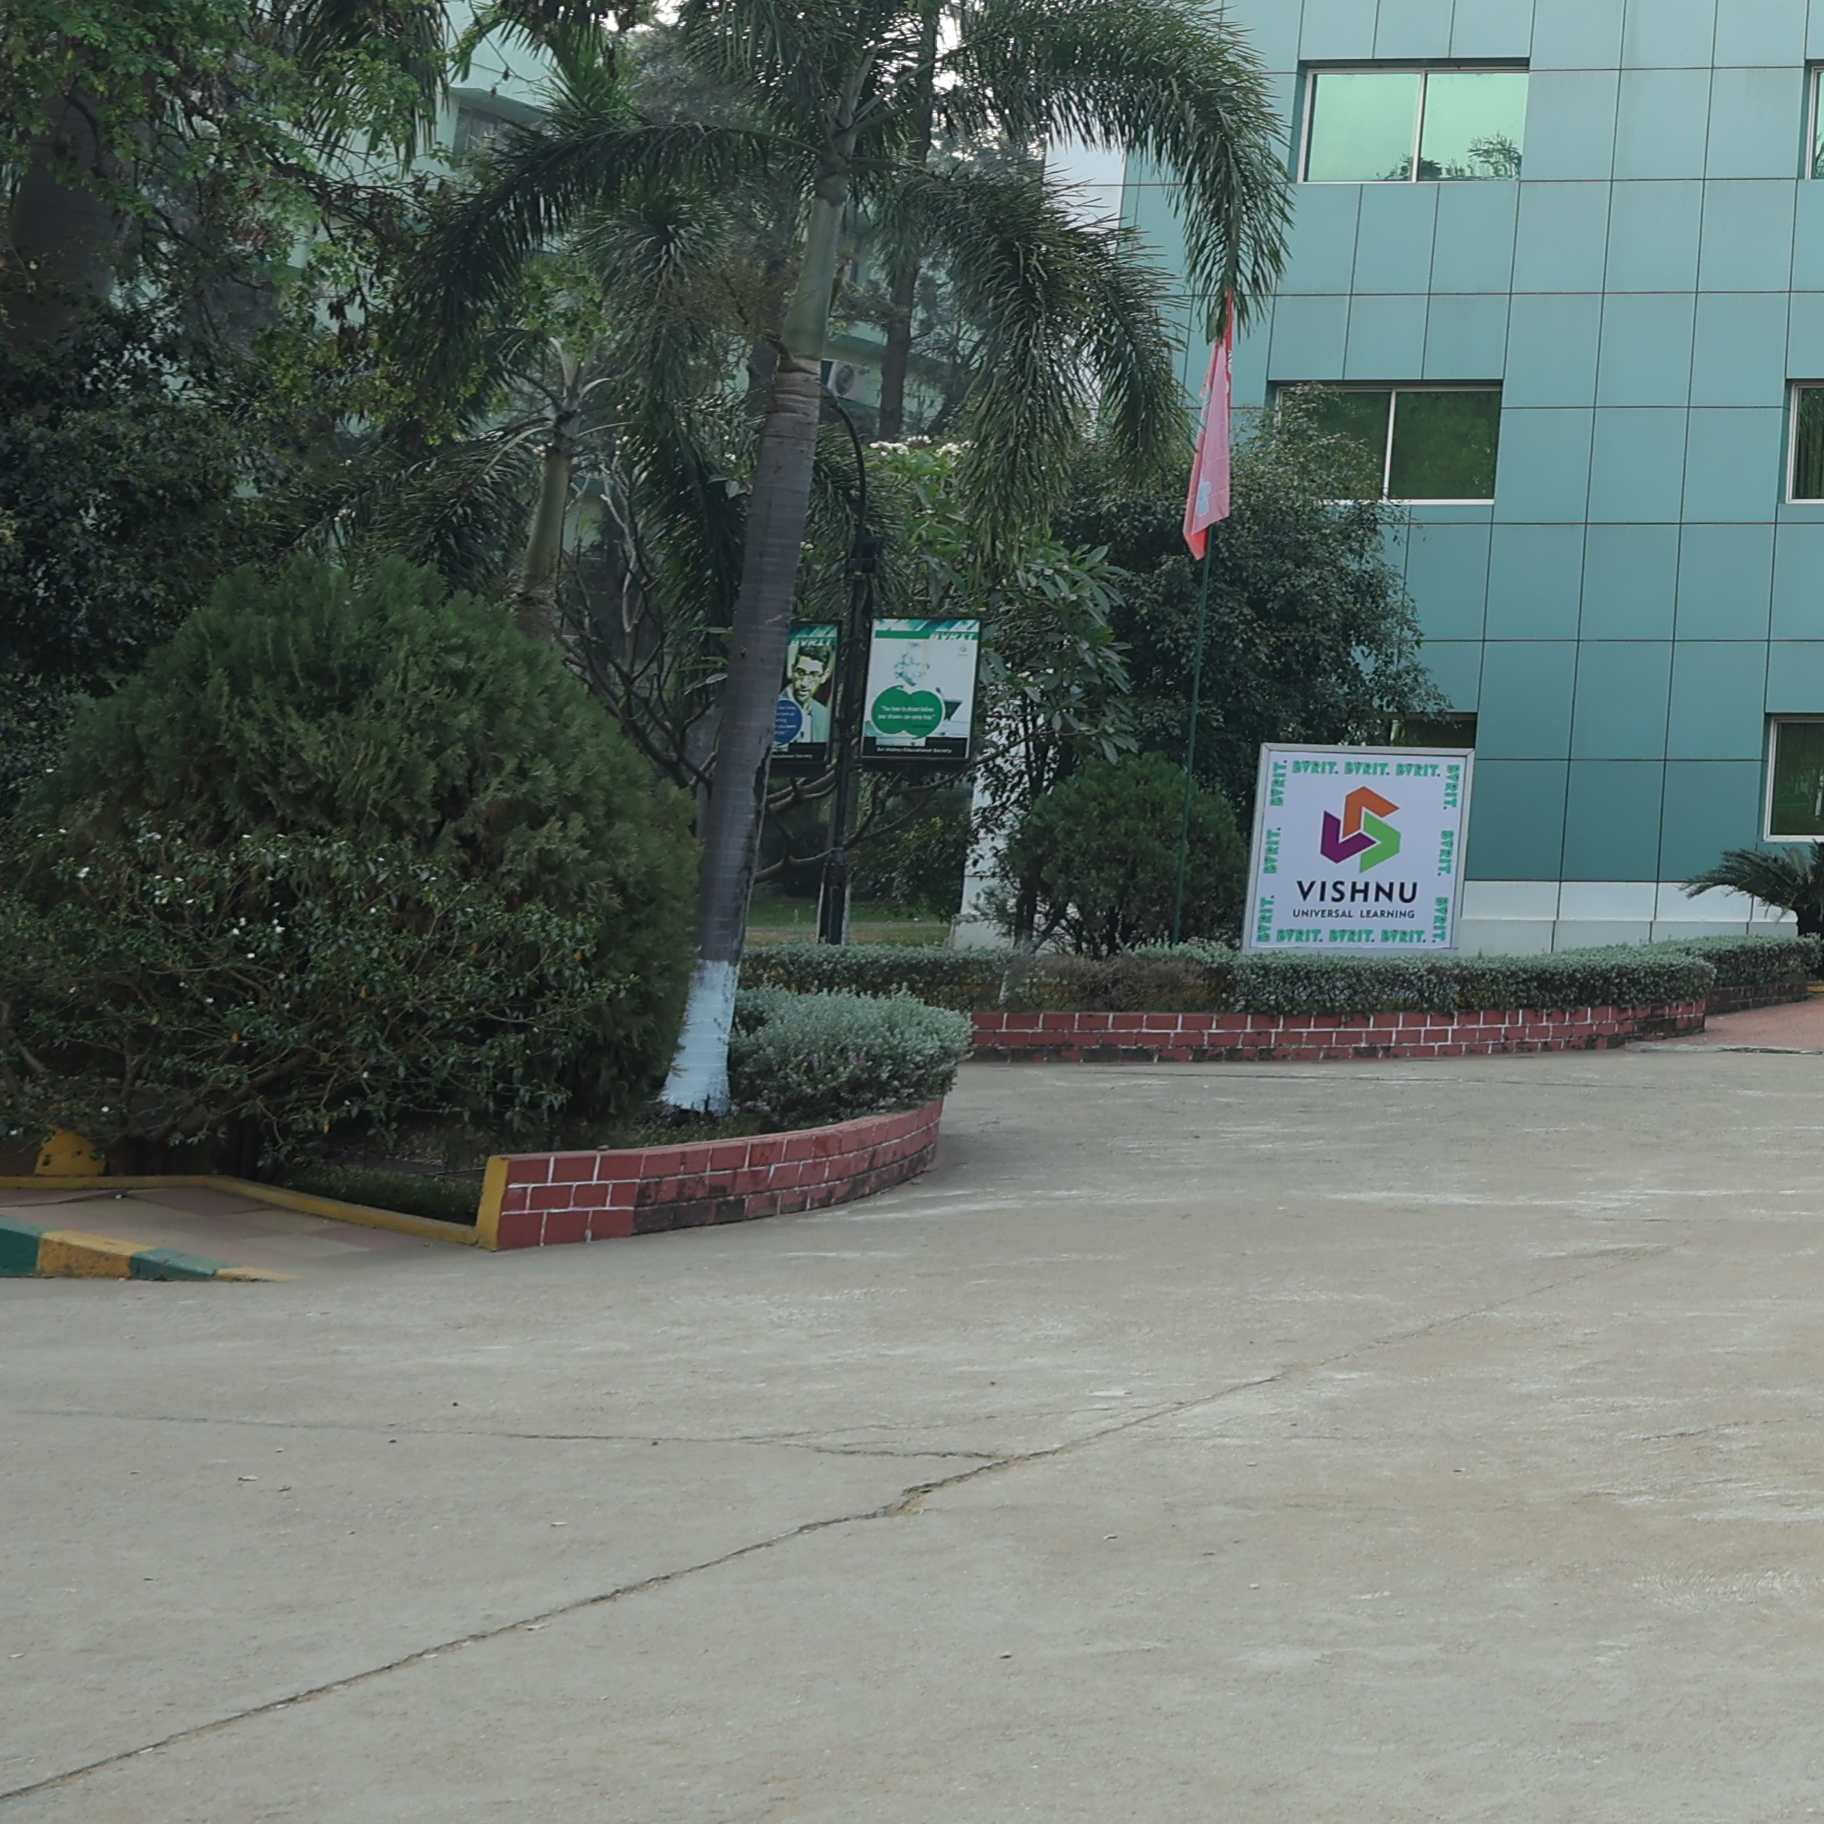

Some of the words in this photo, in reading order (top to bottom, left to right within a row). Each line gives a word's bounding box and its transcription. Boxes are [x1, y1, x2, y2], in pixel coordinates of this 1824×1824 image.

[1293, 760, 1339, 775] BVRIT.
[1344, 760, 1390, 776] BVRIT.
[1396, 762, 1441, 778] BVRIT.
[1296, 880, 1418, 904] VISHNU
[1292, 909, 1353, 918] UNIVERSAL
[1360, 909, 1415, 919] LEARNING
[1276, 929, 1323, 943] BVRIT.
[1329, 929, 1375, 943] BVRIT.
[1381, 929, 1427, 943] BVRIT.
